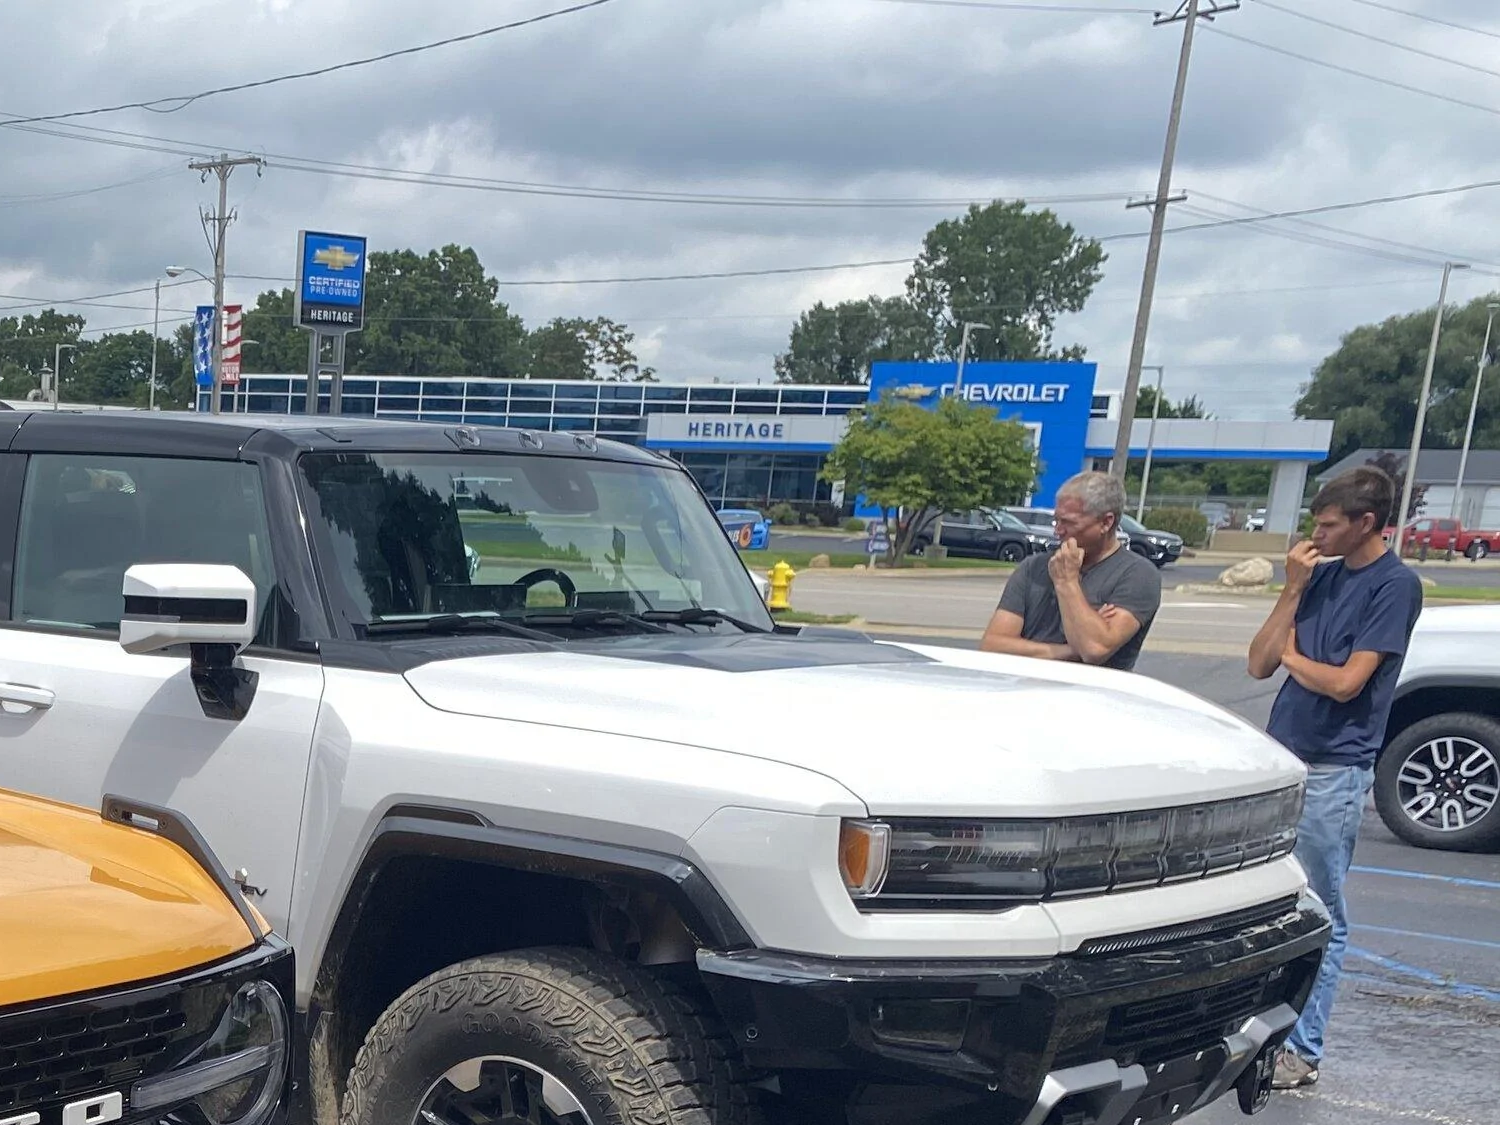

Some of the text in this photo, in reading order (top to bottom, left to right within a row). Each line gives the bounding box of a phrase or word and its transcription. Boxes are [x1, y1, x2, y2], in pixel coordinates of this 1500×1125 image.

[308, 275, 360, 289] CERTIFIED
[310, 309, 354, 323] HERITAGE
[939, 382, 1070, 402] CHEVROLET
[688, 421, 784, 439] HERITAGE
